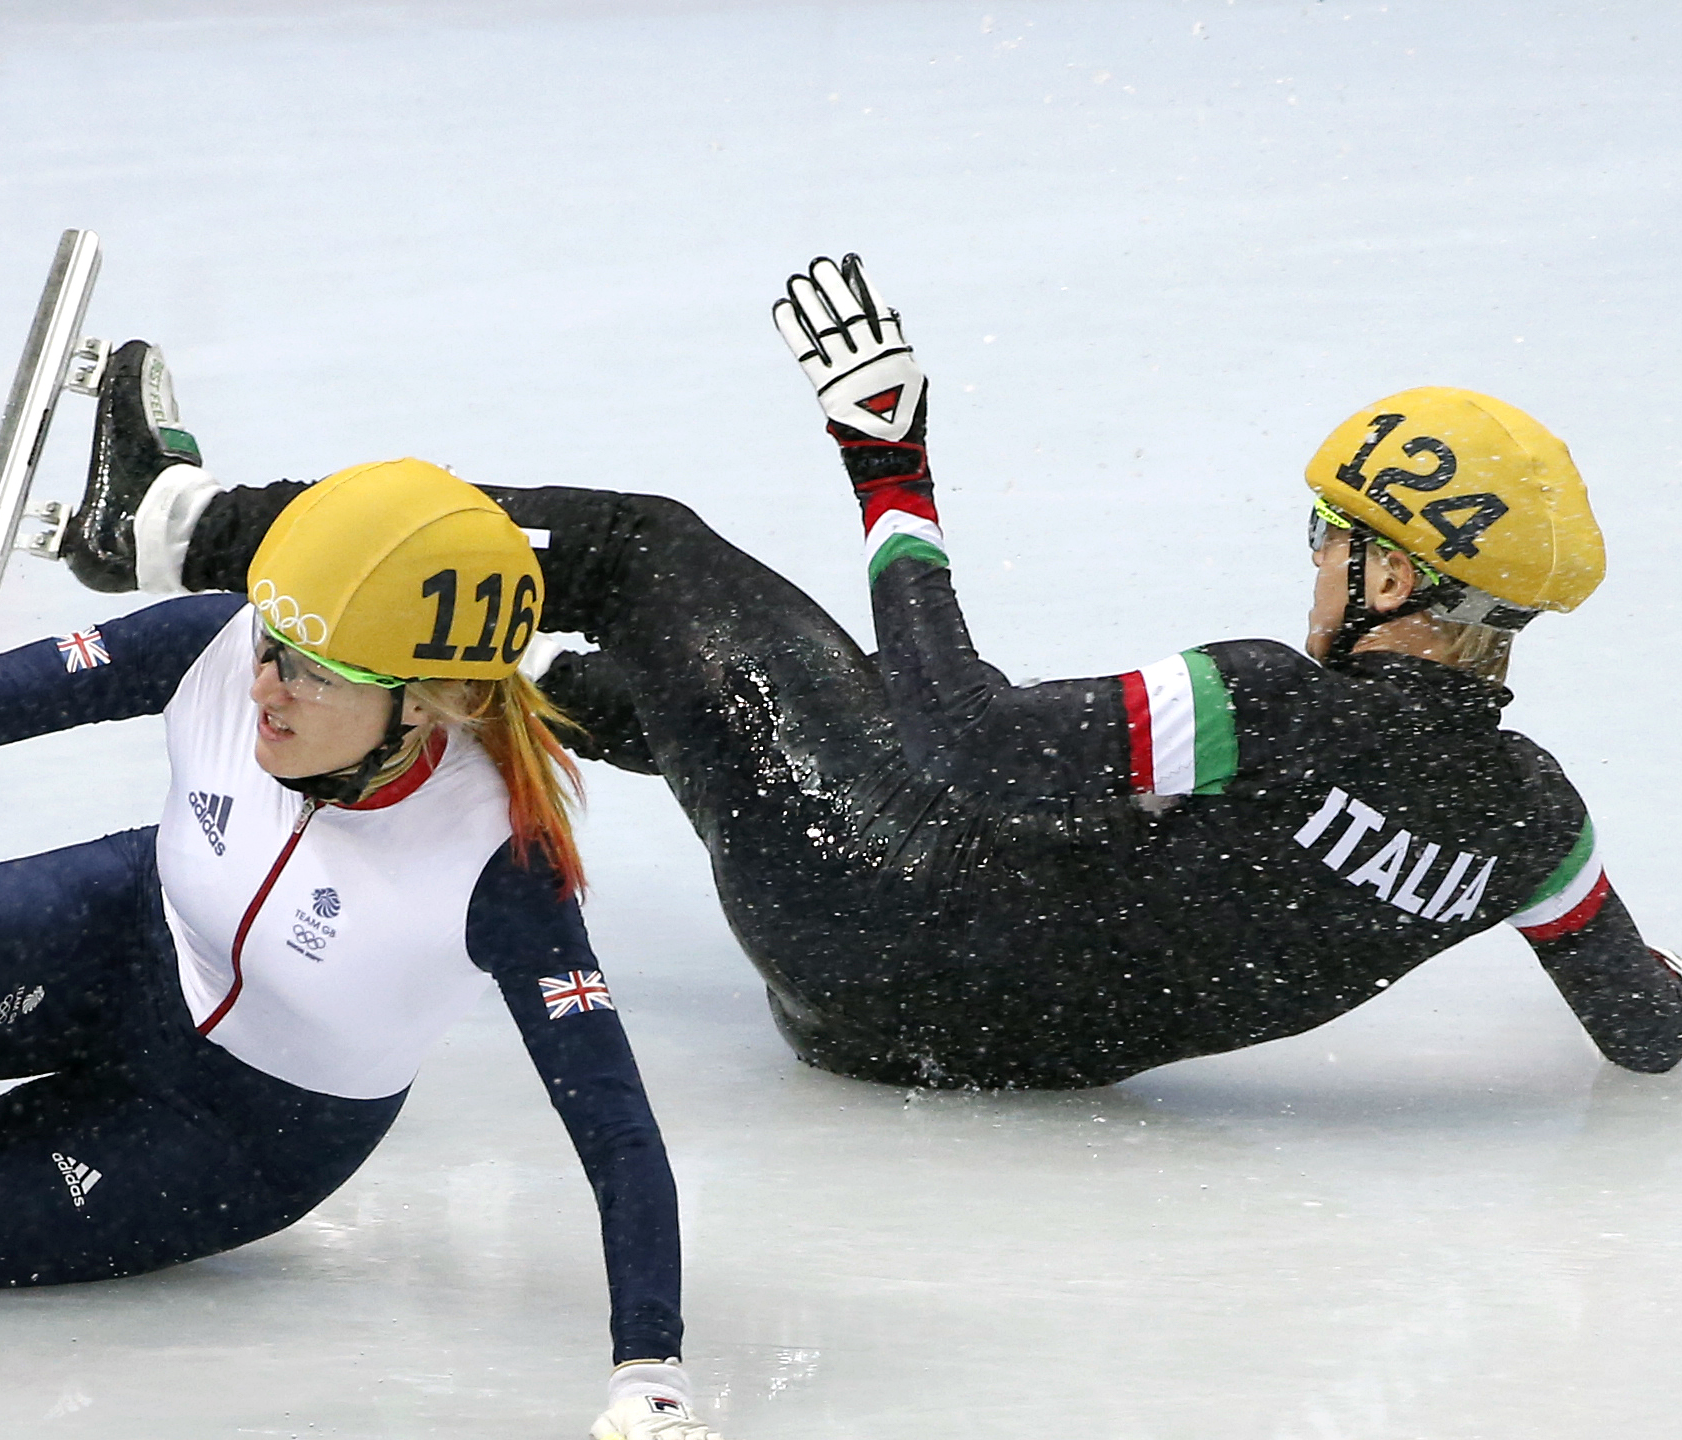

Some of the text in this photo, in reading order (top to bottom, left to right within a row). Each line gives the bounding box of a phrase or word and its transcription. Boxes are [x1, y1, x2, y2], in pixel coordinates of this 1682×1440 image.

[1335, 413, 1509, 562] 124
[412, 568, 539, 664] 116
[187, 791, 226, 857] adidas
[1293, 785, 1499, 924] ITALIA
[294, 908, 337, 938] TEAM GB
[51, 1152, 84, 1207] adidas
